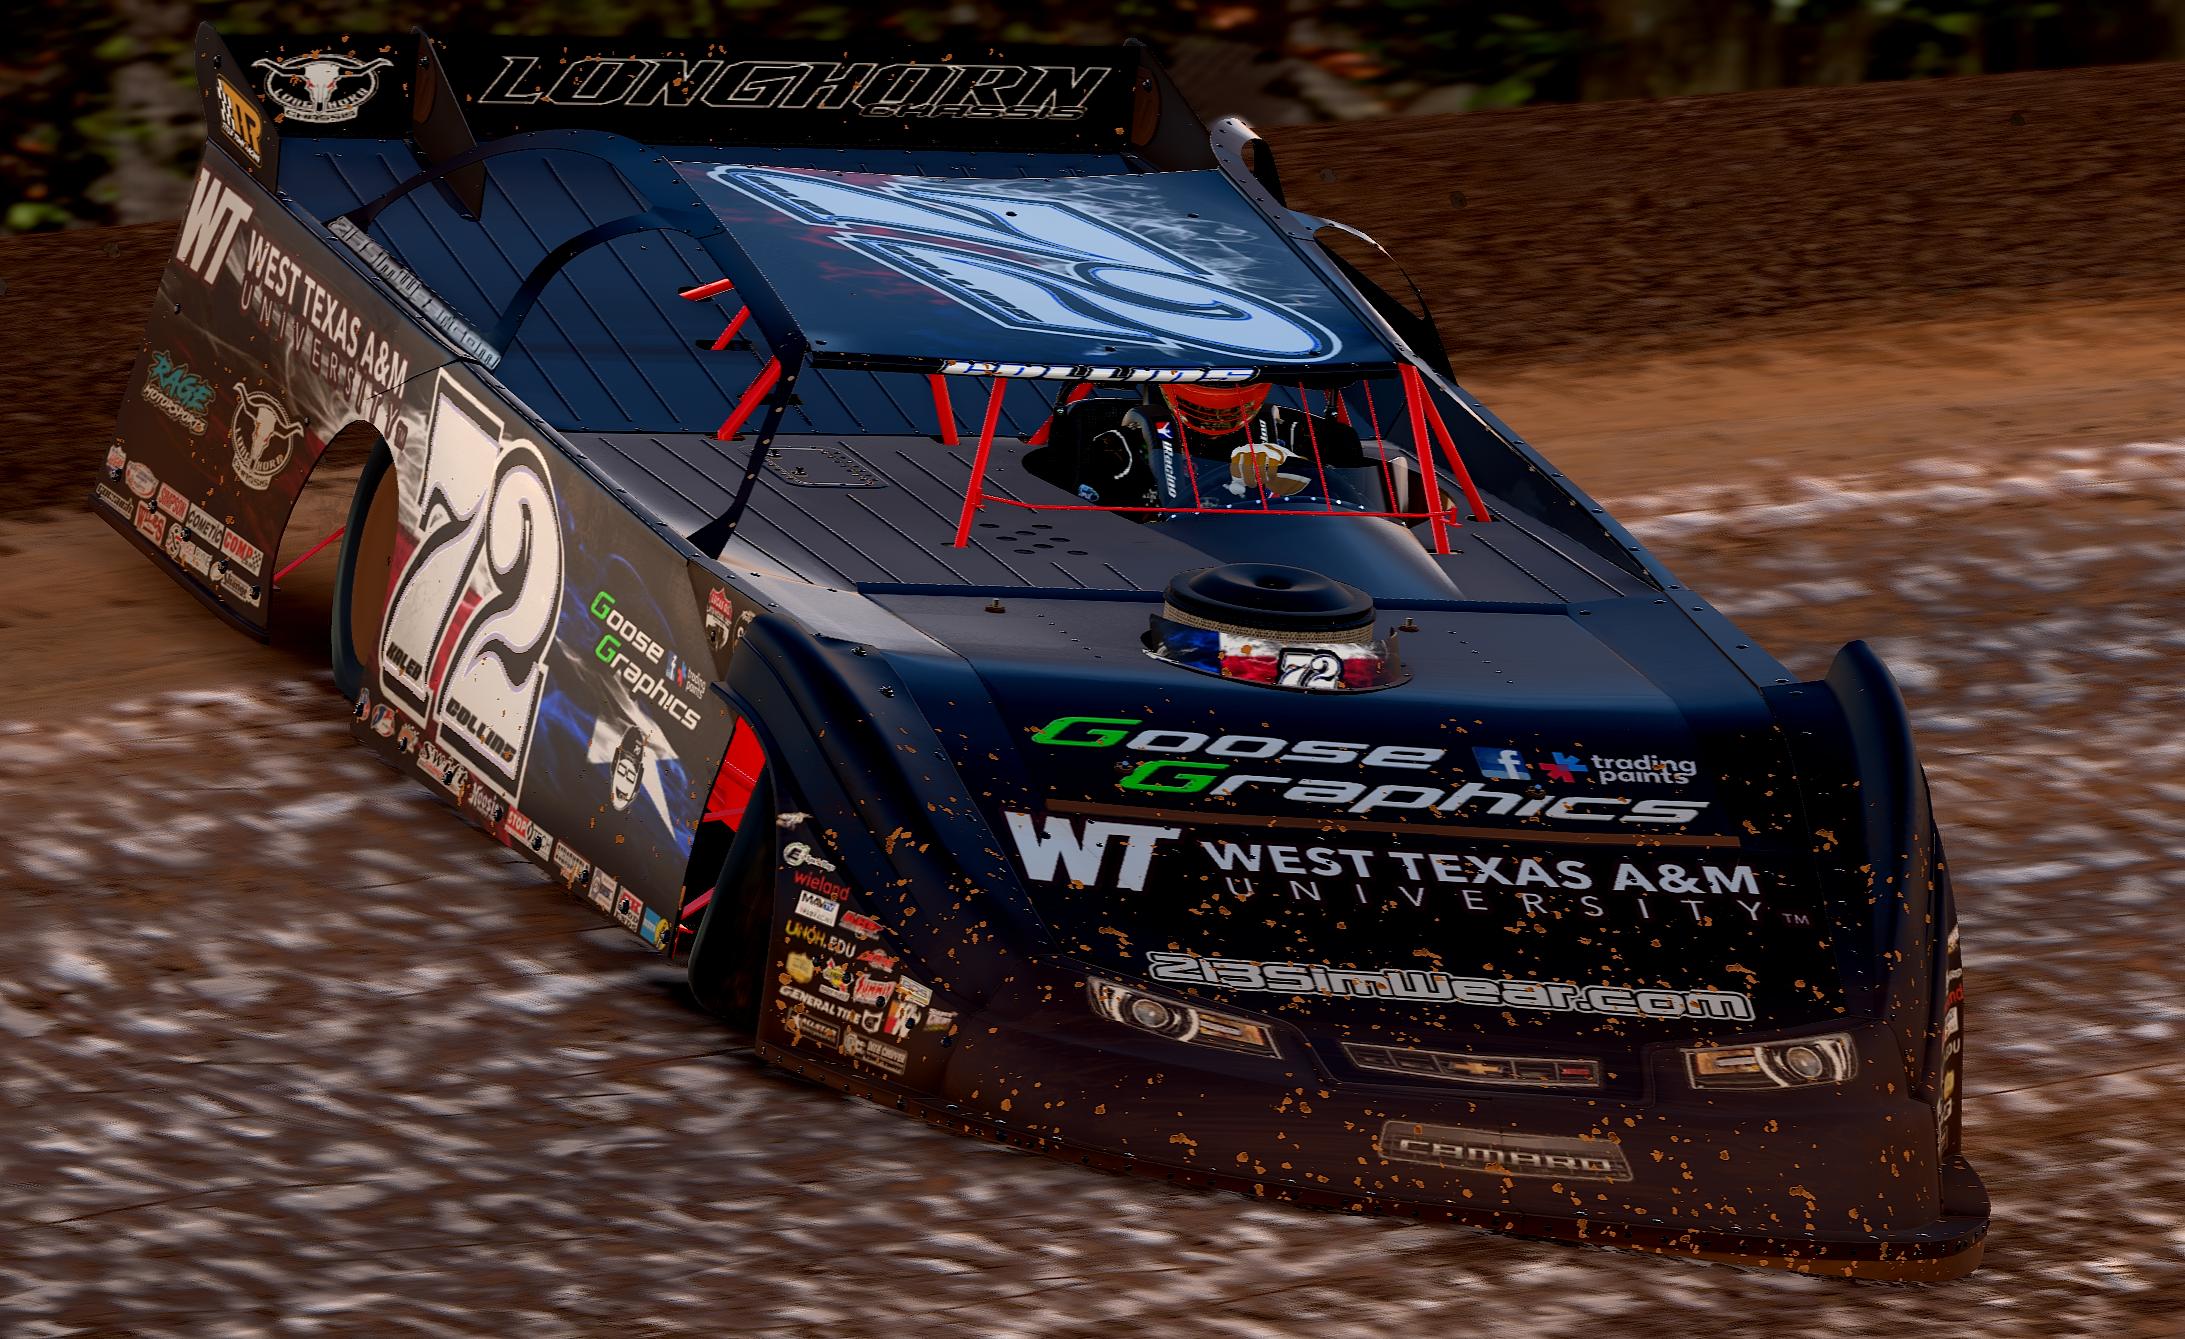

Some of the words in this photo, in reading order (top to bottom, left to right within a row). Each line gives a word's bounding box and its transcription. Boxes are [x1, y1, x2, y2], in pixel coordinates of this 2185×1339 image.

[478, 55, 1113, 110] LONGHORN
[176, 167, 253, 285] WT
[246, 230, 302, 306] WEST
[302, 276, 361, 359] TEXAS
[360, 331, 408, 399] A&M
[151, 351, 213, 412] RAGE
[241, 280, 399, 433] UNIVERSITY
[186, 510, 223, 544] COMETIC
[223, 532, 254, 560] COMP
[380, 367, 565, 806] 72
[590, 590, 665, 665] Goose
[385, 642, 423, 682] KALEB
[595, 634, 703, 731] Graphics
[1279, 648, 1343, 690] 72
[446, 697, 518, 763] COLLINS
[1031, 716, 1446, 770] Goose
[1119, 760, 1710, 824] Graphics
[1590, 754, 1698, 777] trading
[1598, 768, 1691, 786] paints
[468, 782, 504, 821] Hoosi
[1004, 811, 1183, 892] WT
[1201, 841, 1375, 878] WEST
[1388, 851, 1593, 890] TEXAS
[1612, 863, 1761, 895] A&M
[1225, 877, 1763, 922] UNIVERSITY
[785, 920, 857, 958] UNOH.EDU
[779, 985, 836, 1016] GENERAL
[1401, 1139, 1613, 1172] CAMARO
